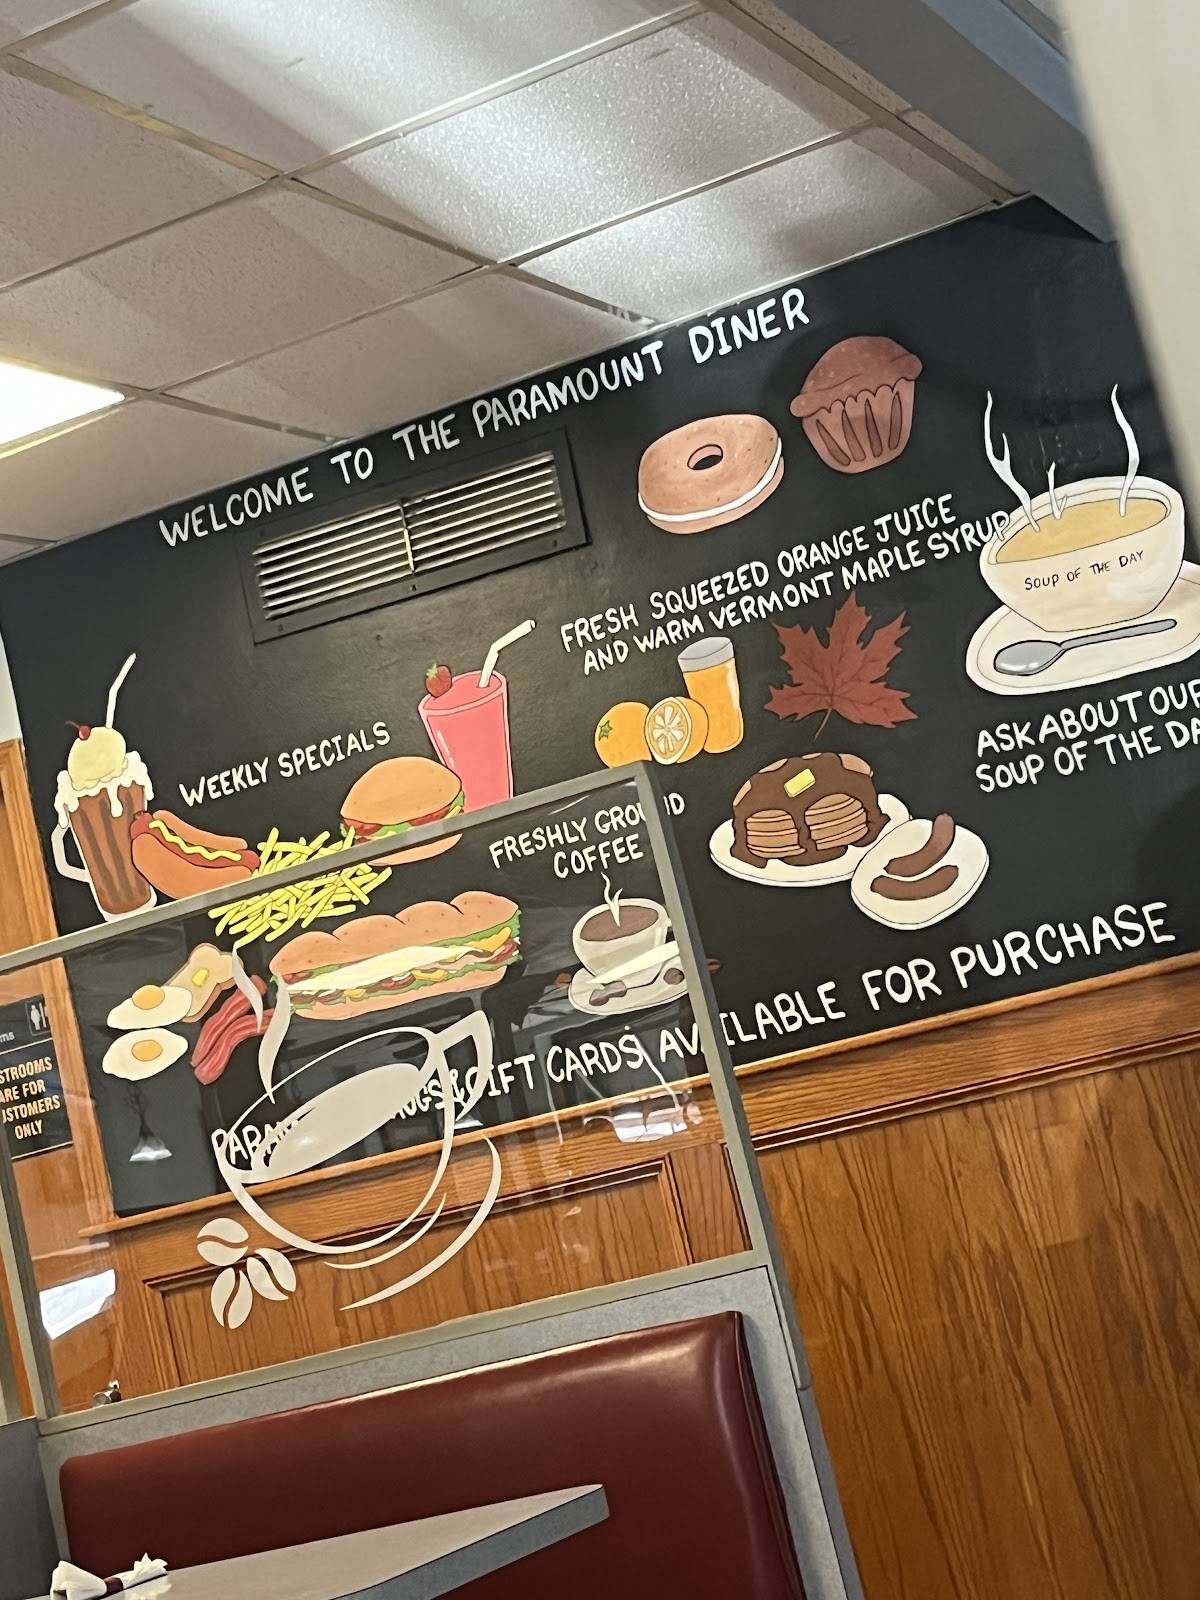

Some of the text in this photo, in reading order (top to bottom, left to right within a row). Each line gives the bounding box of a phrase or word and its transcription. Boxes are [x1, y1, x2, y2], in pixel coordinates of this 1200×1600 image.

[159, 288, 810, 547] WELCOME TO THE PARAMOUNT DINER
[560, 493, 956, 652] FRESH SQUEEZED ORANGE JUICE
[1024, 550, 1144, 591] SOUP OF THE DAY
[584, 640, 629, 675] AND
[633, 614, 704, 653] WARM
[709, 572, 833, 630] VERMONT
[841, 539, 925, 590] MAPLE
[977, 721, 1035, 758] ASK
[1038, 690, 1143, 743] ABOUT
[179, 721, 391, 807] WEEKLY SPECIALS
[976, 754, 1045, 793] SOUP
[1054, 740, 1088, 775] OF
[1094, 725, 1161, 765] THE
[489, 817, 587, 869] FRESHLY
[553, 833, 644, 879] COFFEE
[546, 1034, 645, 1083] CARDS
[660, 981, 846, 1063] AVILABLE
[861, 958, 942, 1011] FOR
[950, 901, 1176, 989] PURCHASE
[22, 1079, 46, 1098] FOR
[15, 1119, 43, 1140] ONLY
